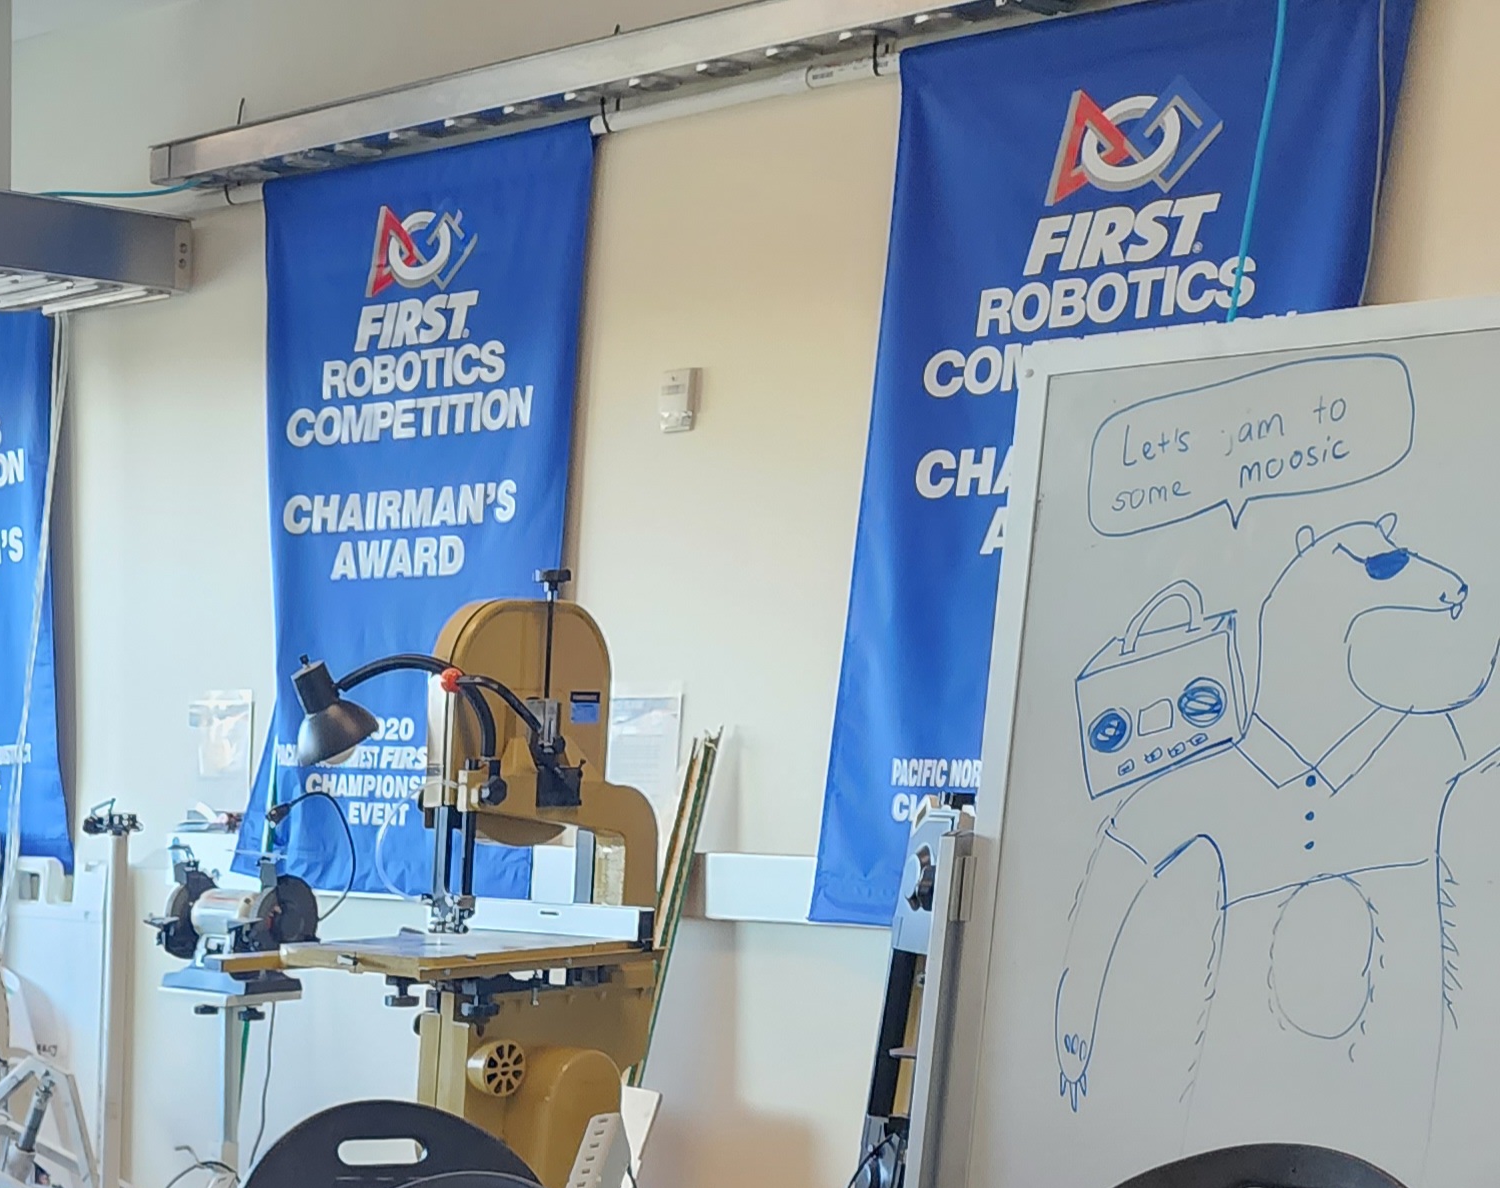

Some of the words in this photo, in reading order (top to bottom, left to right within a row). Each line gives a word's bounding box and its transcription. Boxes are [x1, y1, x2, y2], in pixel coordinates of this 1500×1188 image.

[975, 255, 1257, 337] ROBOTICS
[321, 339, 506, 400] ROBOTICS
[286, 384, 534, 448] COMPETITION
[1121, 423, 1191, 467] Let's
[1221, 413, 1286, 457] jam
[1313, 396, 1348, 424] to
[1110, 480, 1192, 513] some
[1238, 434, 1351, 489] moosic
[283, 479, 517, 535] CHAIRMAN'S
[330, 534, 465, 581] AWARD
[368, 717, 415, 742] 020
[378, 745, 428, 771] FIRS
[890, 757, 948, 788] PACIFIC
[305, 772, 427, 799] CHAMPIONS
[347, 801, 410, 828] EVENT
